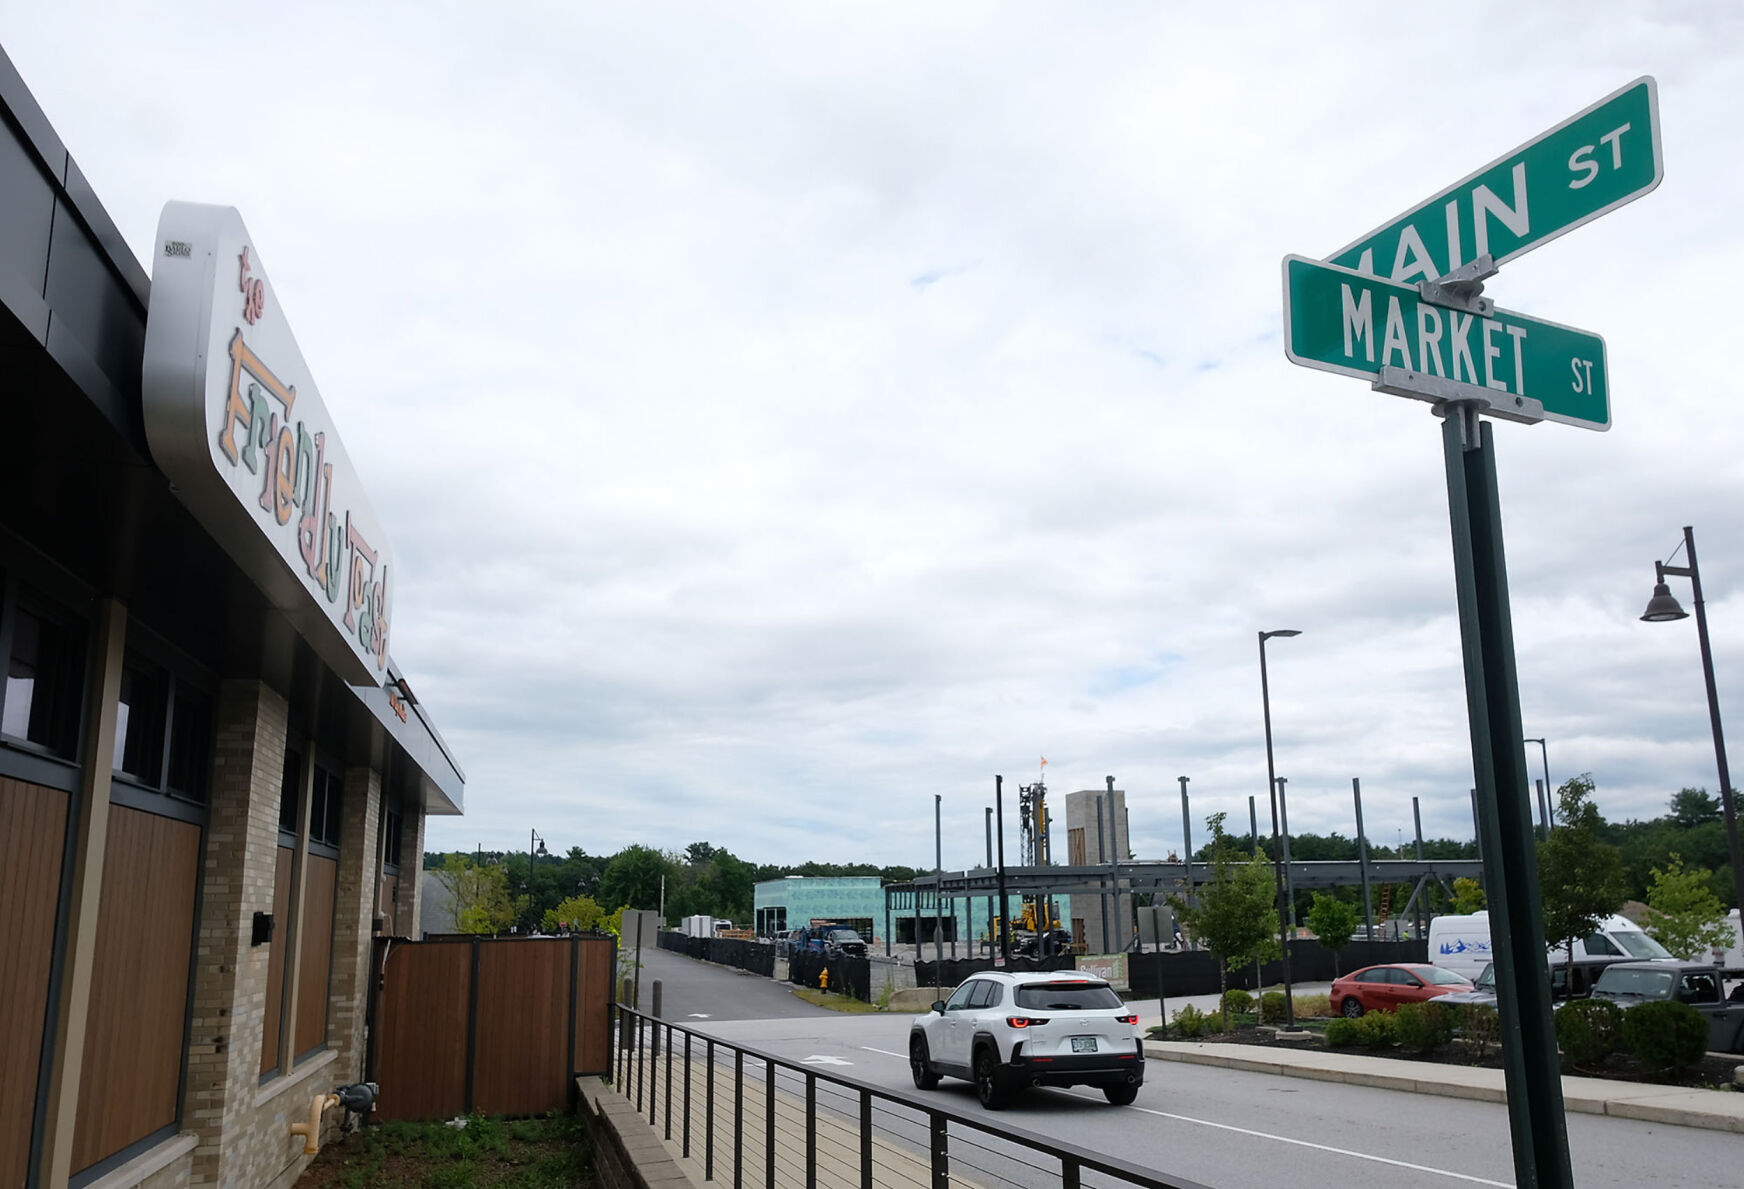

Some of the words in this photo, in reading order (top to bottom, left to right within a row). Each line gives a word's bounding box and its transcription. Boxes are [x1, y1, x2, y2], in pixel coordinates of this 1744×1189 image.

[1357, 161, 1531, 284] AIN
[1568, 122, 1631, 190] ST
[1341, 282, 1527, 396] MARKET
[1571, 357, 1594, 395] ST
[219, 326, 344, 604] Friendly
[343, 510, 388, 671] Toast
